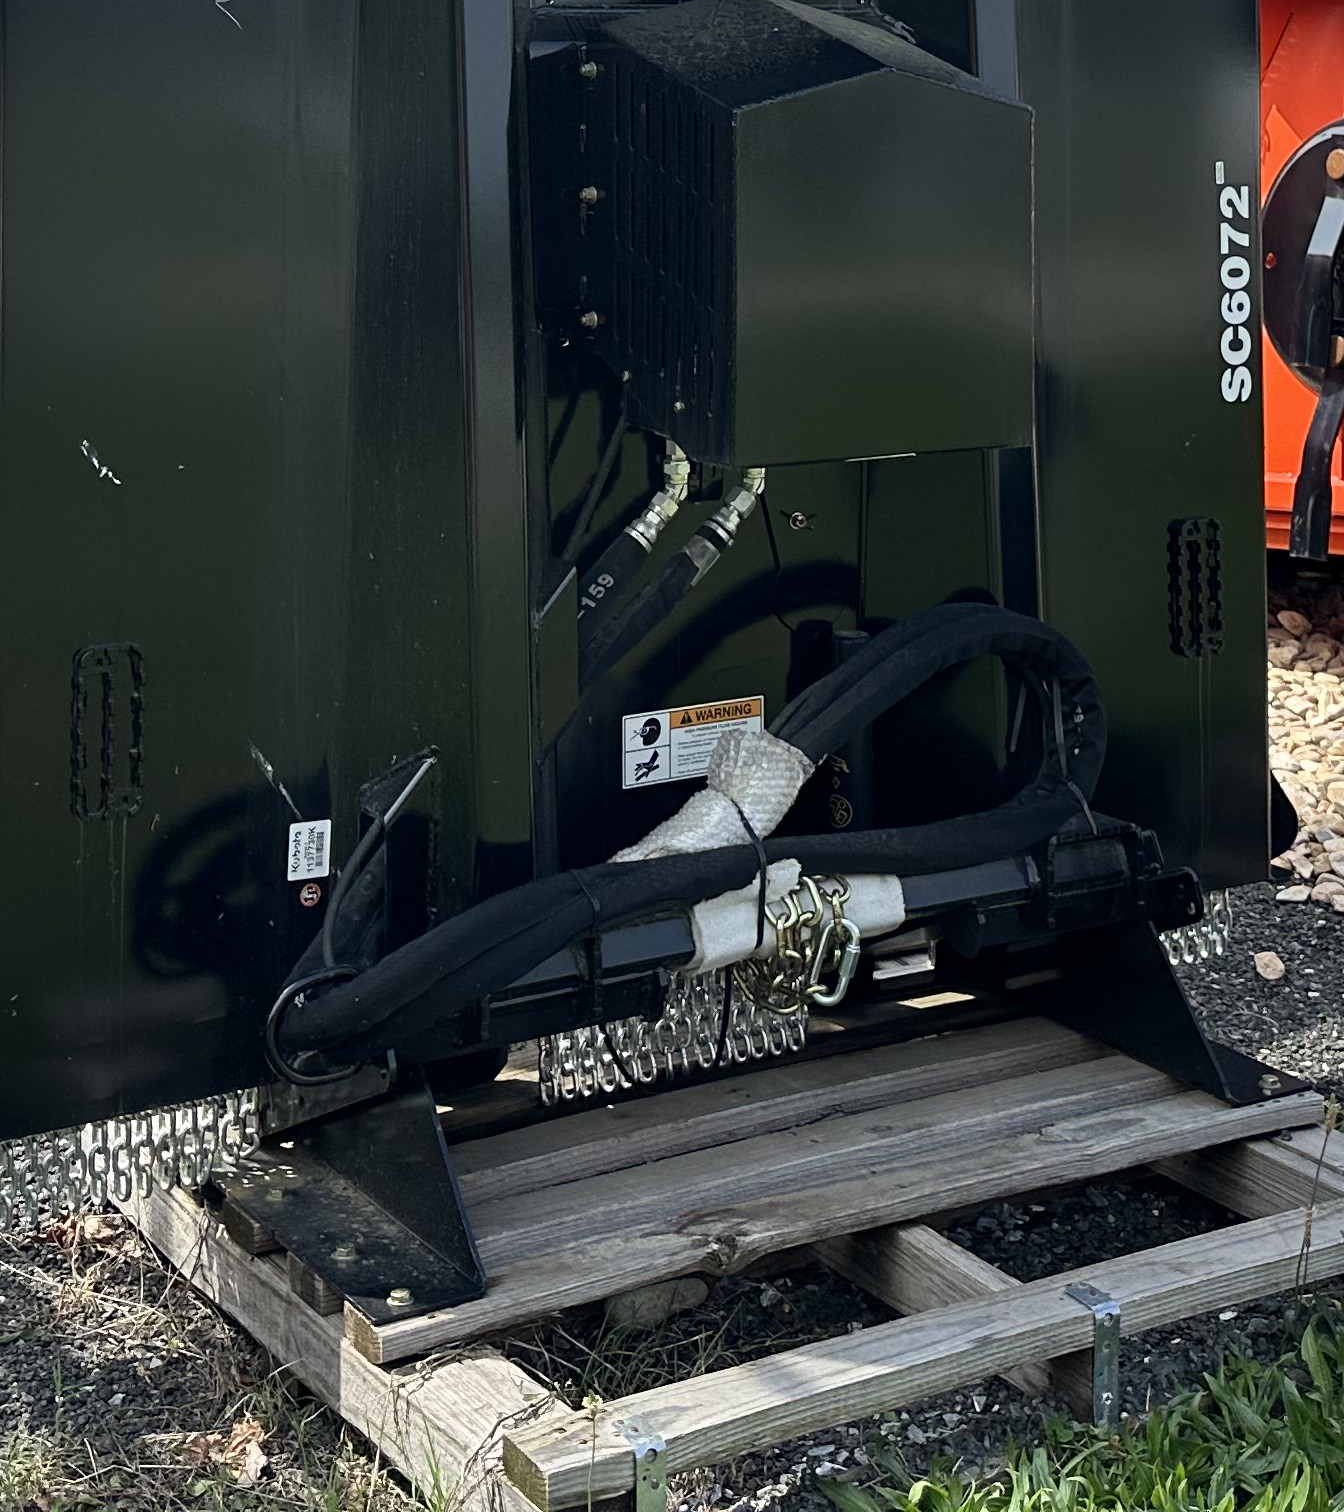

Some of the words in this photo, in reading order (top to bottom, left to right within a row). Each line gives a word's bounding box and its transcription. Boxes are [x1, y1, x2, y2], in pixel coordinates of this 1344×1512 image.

[1219, 185, 1251, 403] SC6072
[695, 703, 752, 722] WARNING
[290, 831, 302, 873] Kubota
